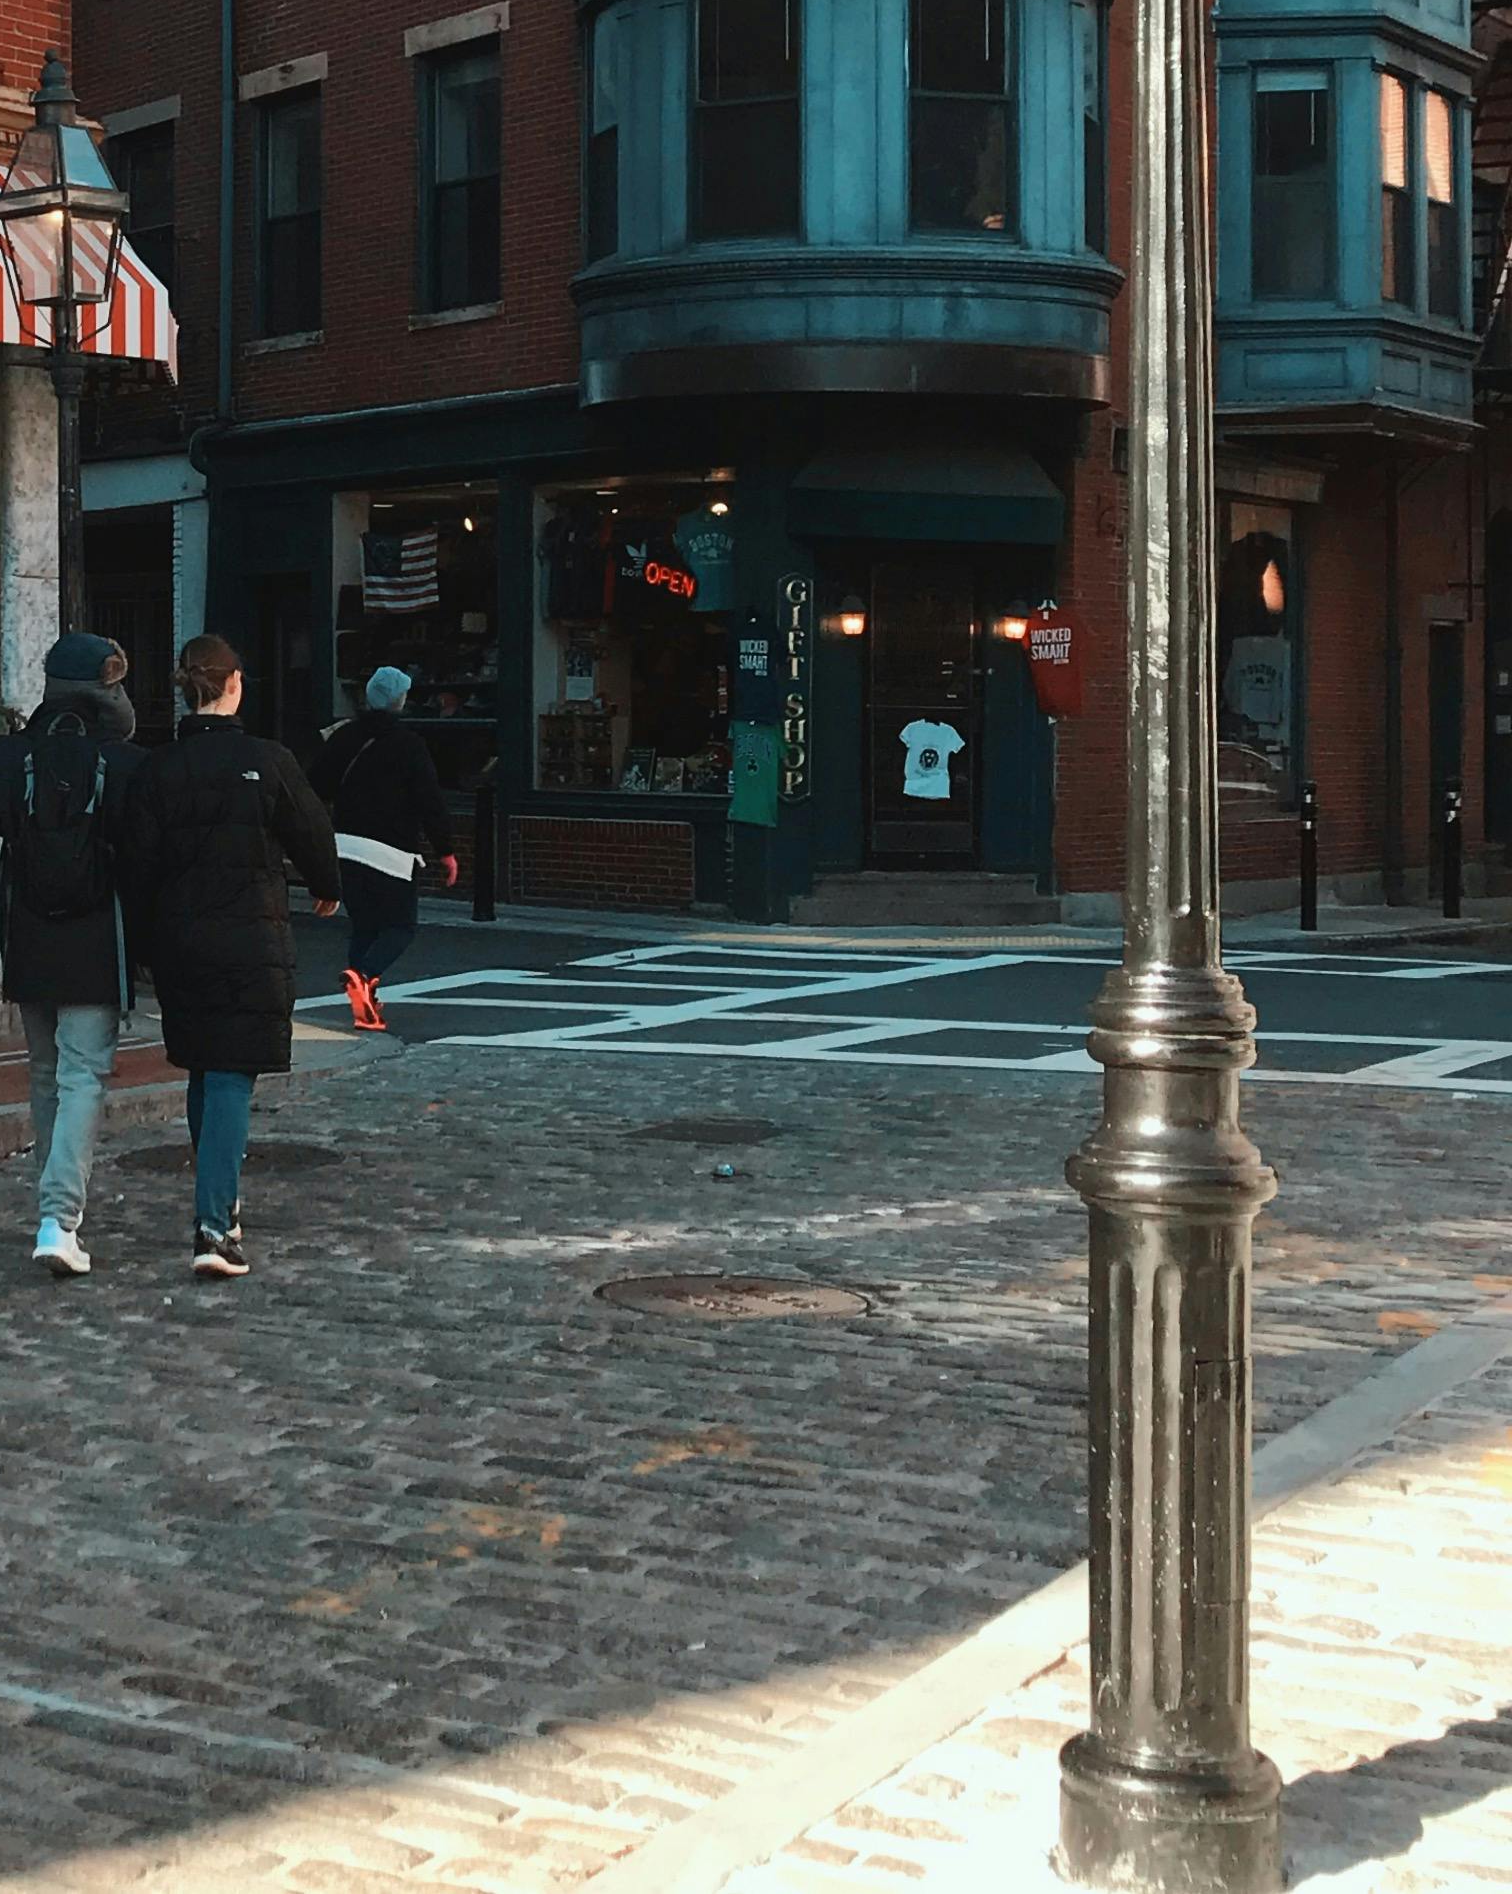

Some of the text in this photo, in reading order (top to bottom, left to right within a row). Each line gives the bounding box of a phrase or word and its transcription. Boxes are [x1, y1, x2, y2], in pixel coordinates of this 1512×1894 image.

[688, 532, 735, 553] BOSTON
[644, 561, 696, 599] OPEN
[1031, 627, 1071, 644] WICKED
[739, 639, 768, 654] WICKED
[1031, 643, 1071, 661] SMAHT
[784, 579, 807, 795] GIFT SHOP
